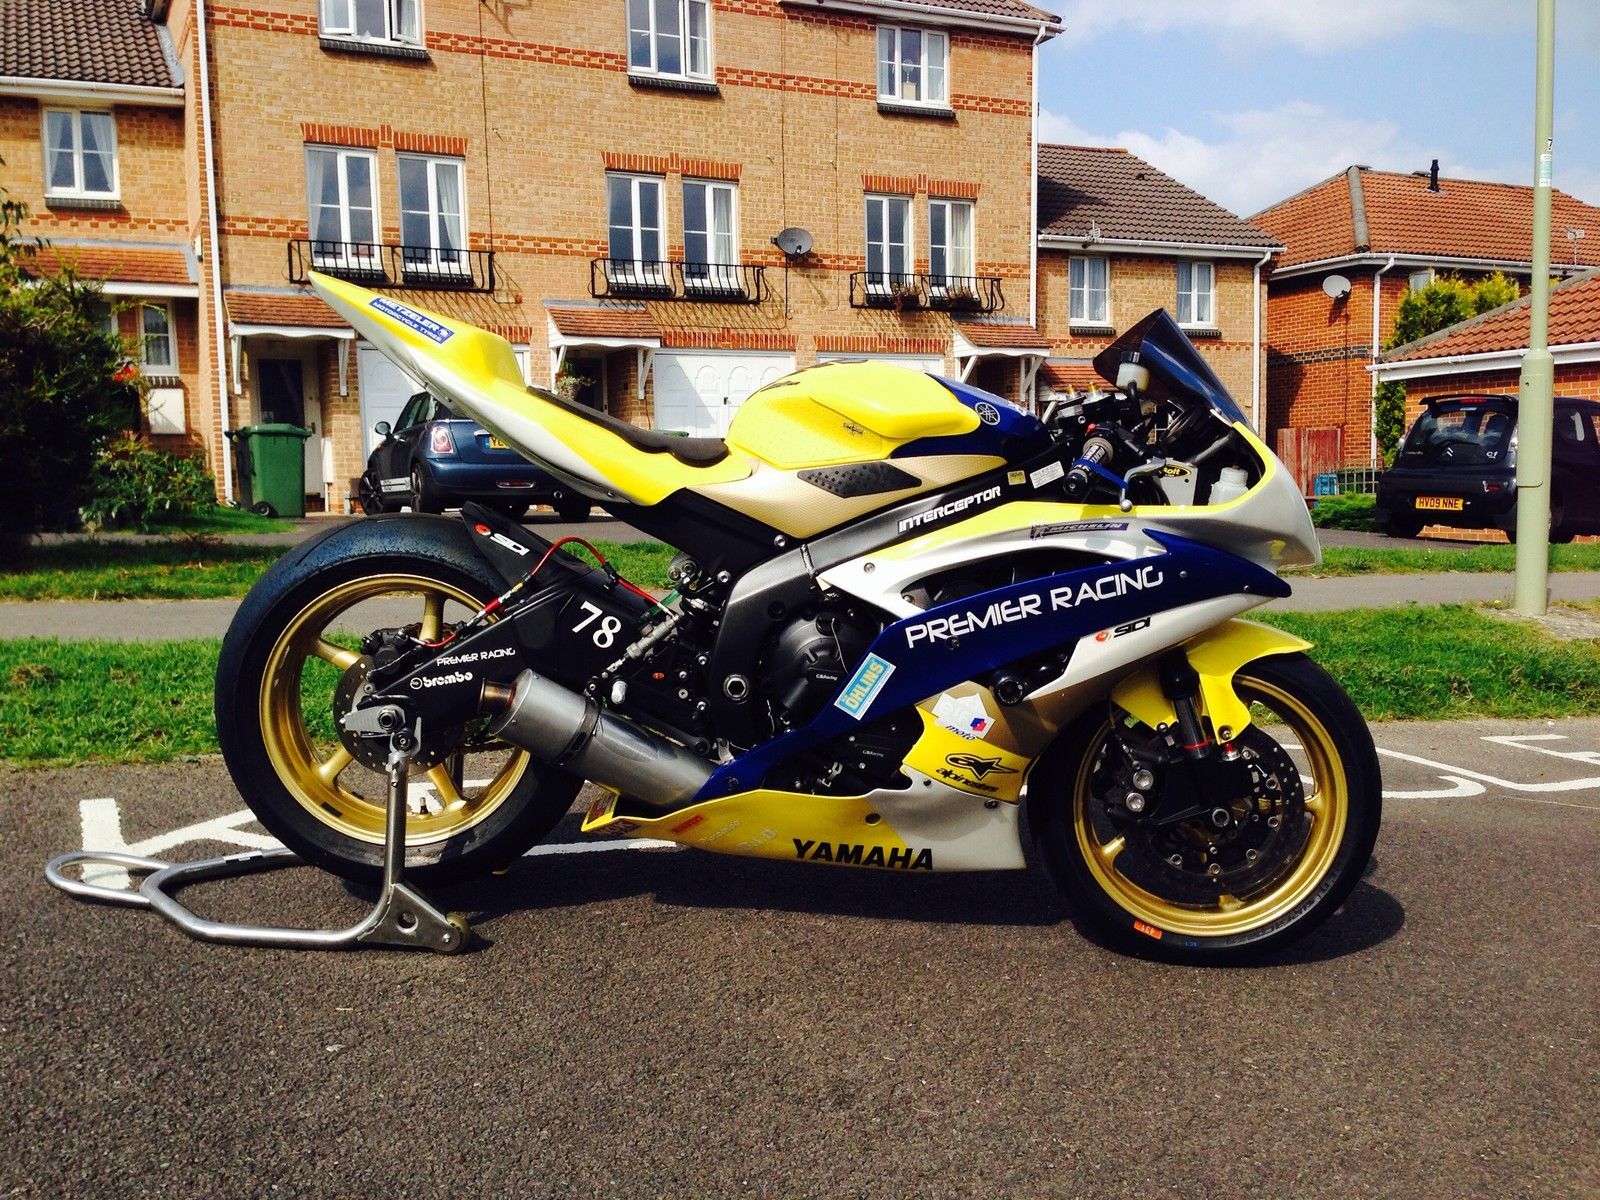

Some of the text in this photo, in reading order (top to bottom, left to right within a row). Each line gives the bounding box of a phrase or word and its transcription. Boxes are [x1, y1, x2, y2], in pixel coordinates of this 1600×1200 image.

[372, 302, 419, 329] MOTORCYCLE
[378, 298, 440, 331] METZELER
[420, 327, 442, 341] TYRES
[898, 485, 1001, 533] INTERCEPTOR
[1419, 498, 1460, 509] HV09 NNE
[1050, 523, 1123, 532] MICHELIN
[905, 565, 1164, 649] PREMIER RACING
[571, 600, 622, 649] 78
[436, 647, 516, 667] PREMIER RACING
[422, 671, 473, 688] brembo
[945, 725, 976, 740] moto
[792, 838, 933, 871] YAMAHA
